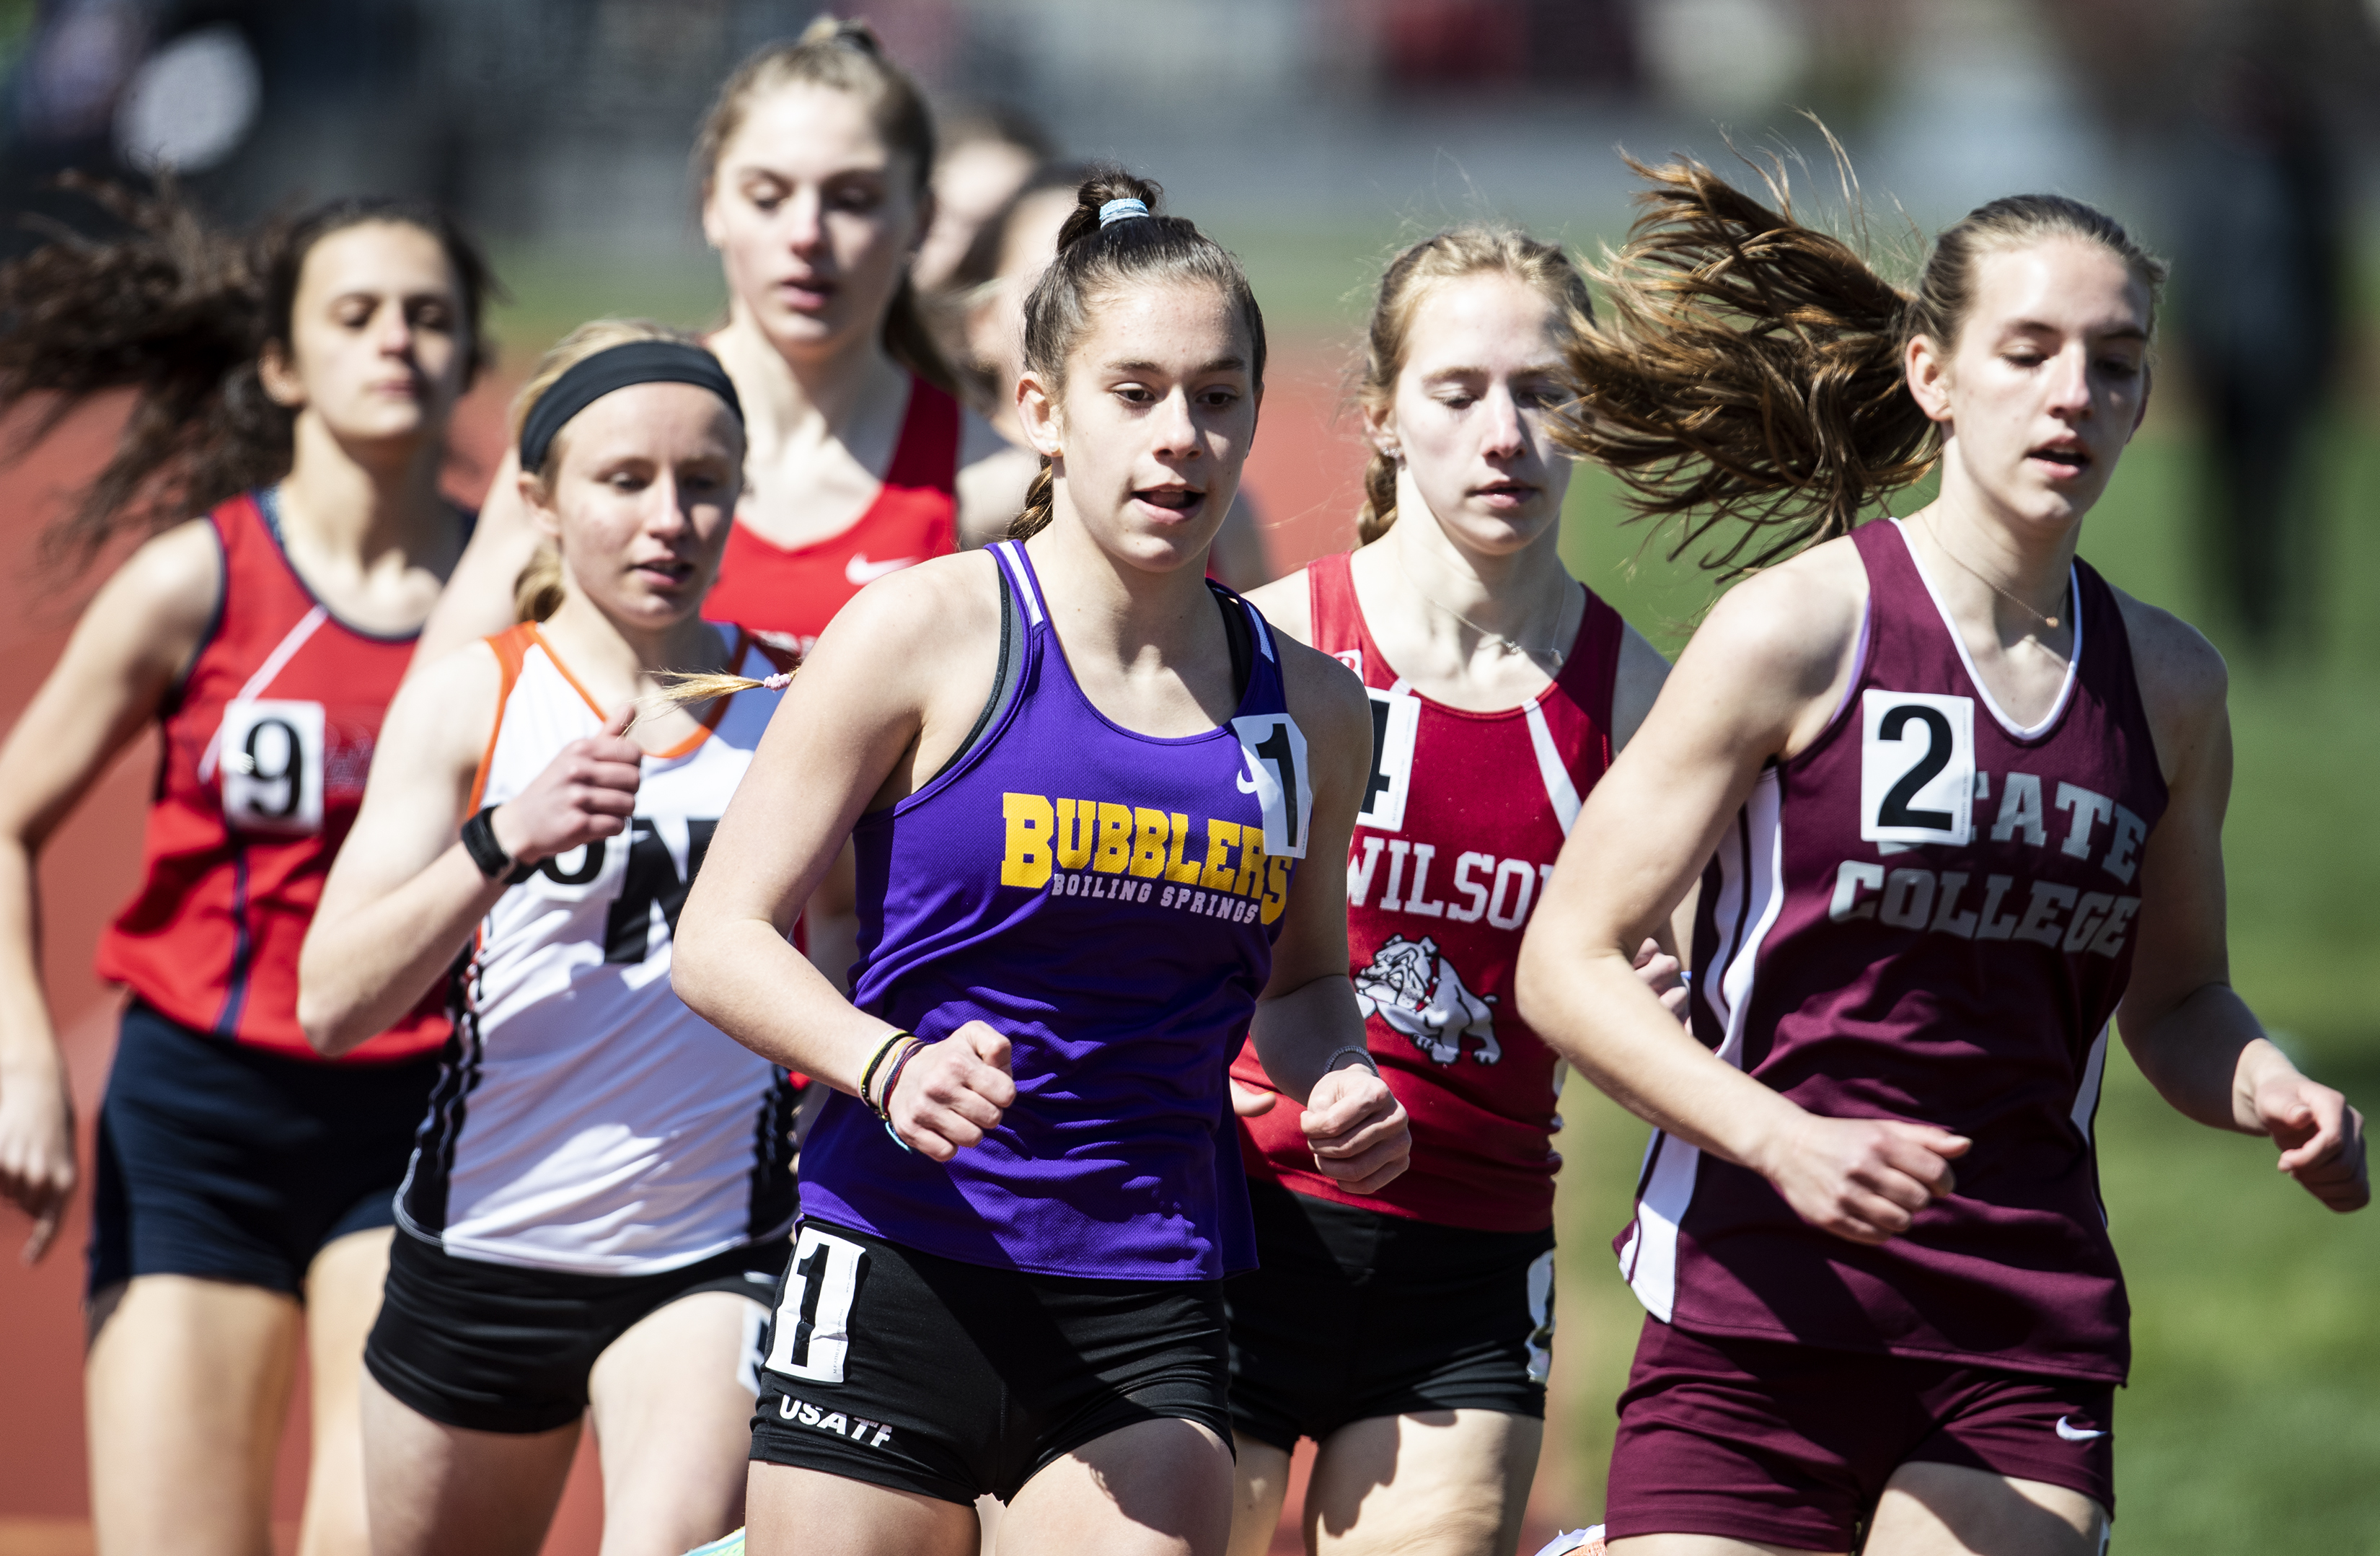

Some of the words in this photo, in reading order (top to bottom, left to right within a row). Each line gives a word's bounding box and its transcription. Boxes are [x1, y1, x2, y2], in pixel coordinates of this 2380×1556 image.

[246, 719, 301, 817] 9
[1255, 723, 1297, 848] 1
[1877, 705, 1953, 832] 2
[1001, 792, 1292, 925] BUBBLERS
[1879, 770, 2147, 885] ATE
[1052, 874, 1152, 903] BOILING
[1160, 886, 1259, 924] SPRINGS
[1347, 835, 1555, 931] WILSO
[1829, 860, 2141, 959] COLLEGE
[790, 1243, 831, 1368] 1
[779, 1394, 893, 1448] USATF
